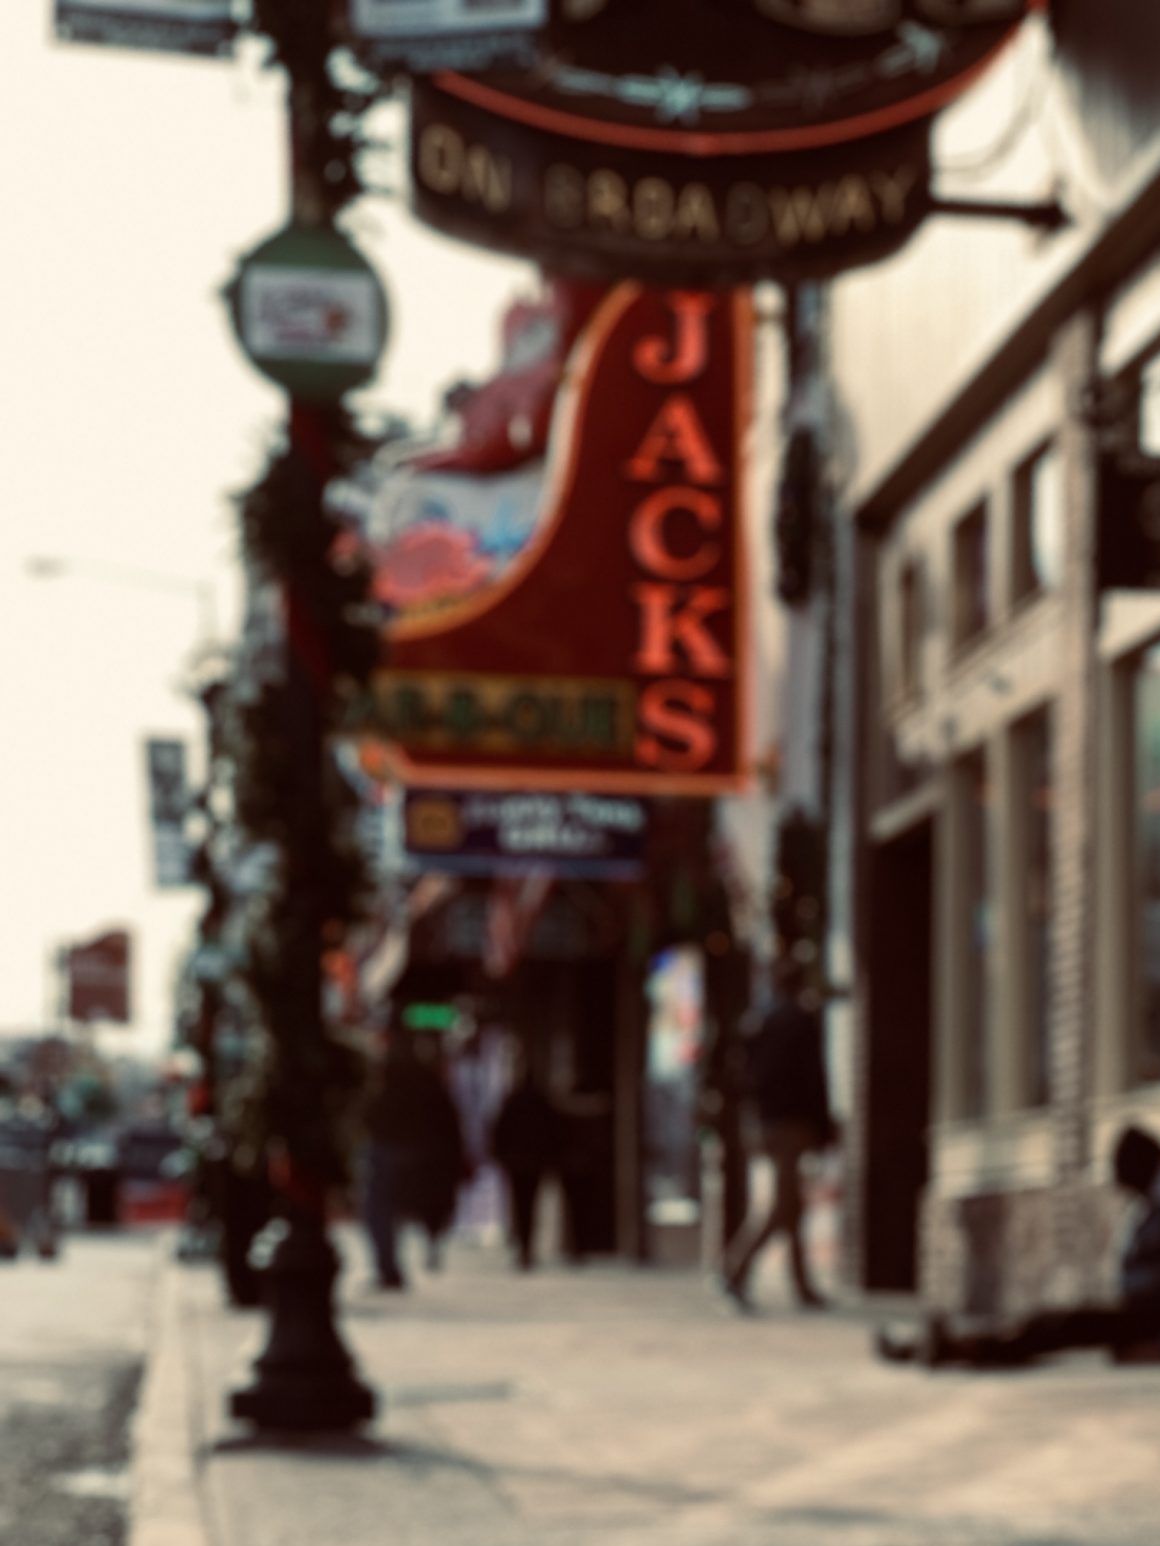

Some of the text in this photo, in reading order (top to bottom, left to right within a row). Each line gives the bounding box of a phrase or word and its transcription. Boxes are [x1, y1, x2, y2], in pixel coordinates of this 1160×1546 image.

[418, 123, 915, 247] ON BROADWAY
[625, 291, 732, 774] JACKS
